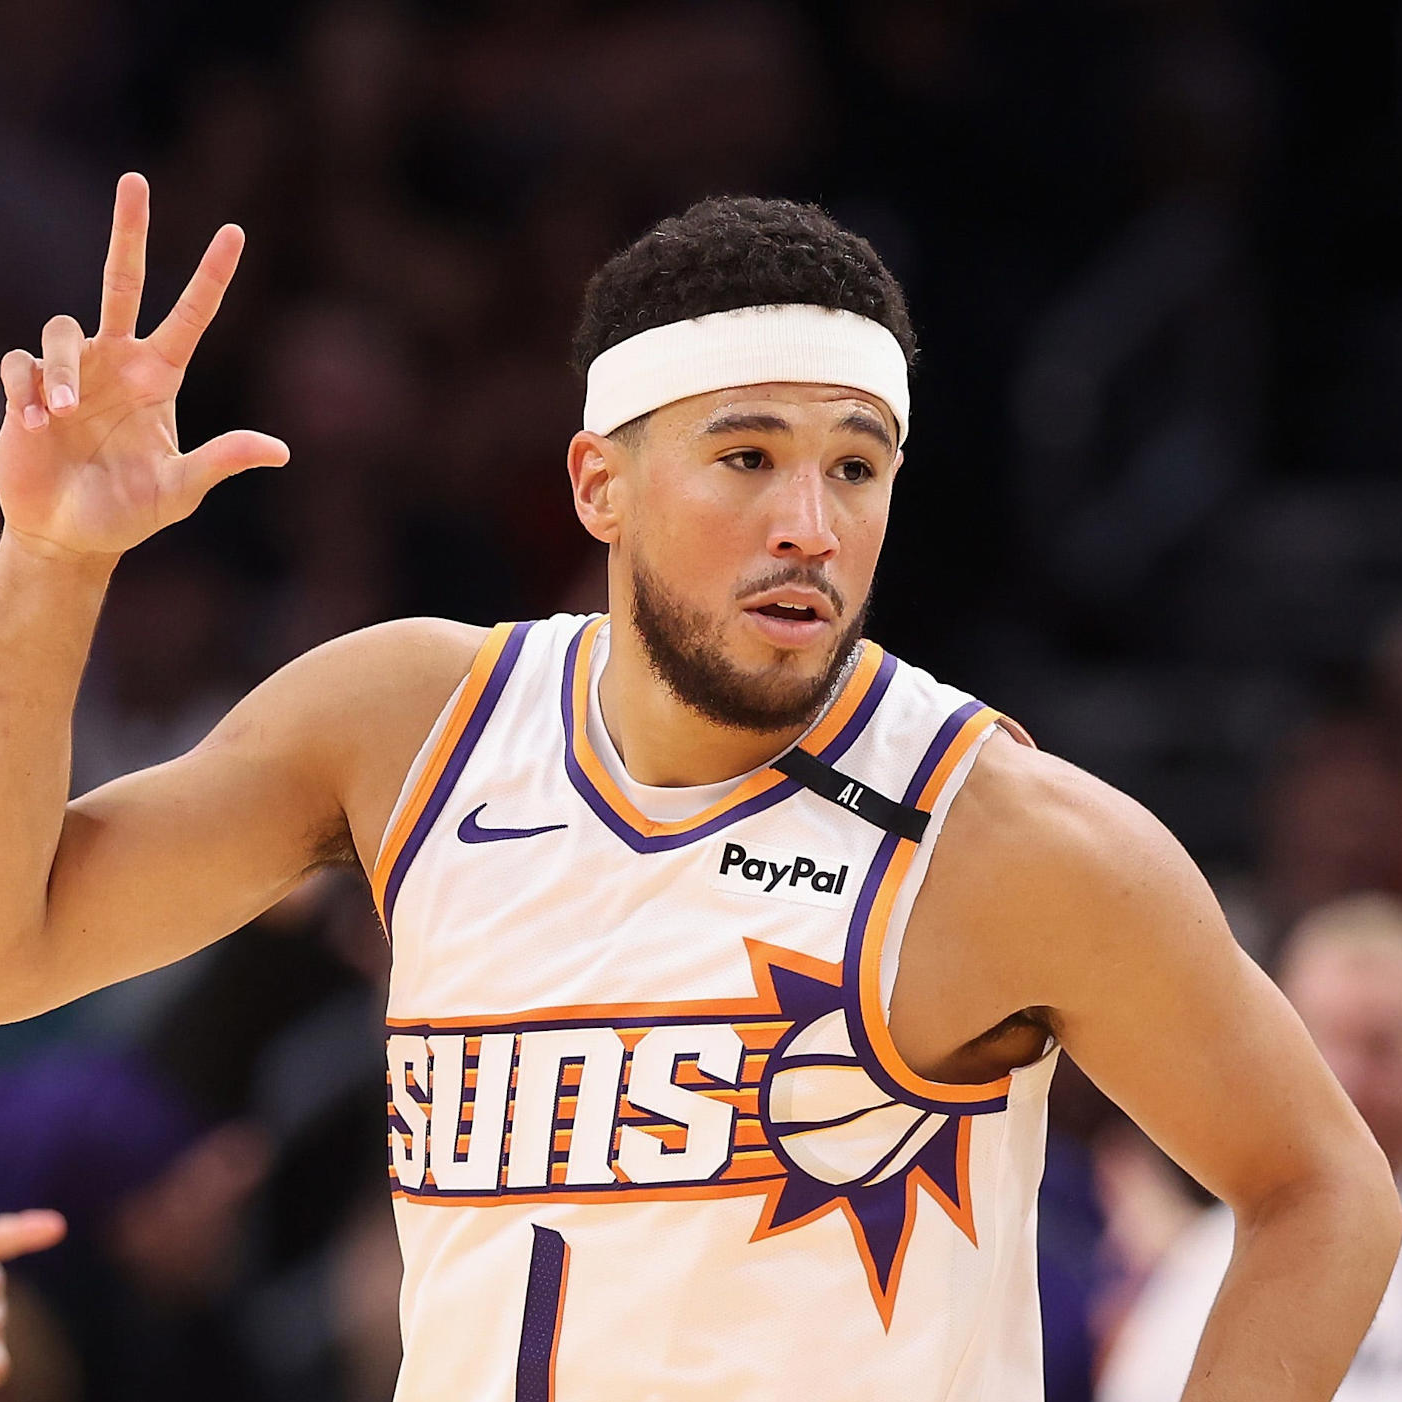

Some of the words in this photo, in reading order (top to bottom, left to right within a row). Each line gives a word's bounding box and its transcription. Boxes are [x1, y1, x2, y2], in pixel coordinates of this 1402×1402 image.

[836, 781, 864, 811] AL
[719, 842, 849, 895] PayPal
[385, 1023, 745, 1192] SUNS
